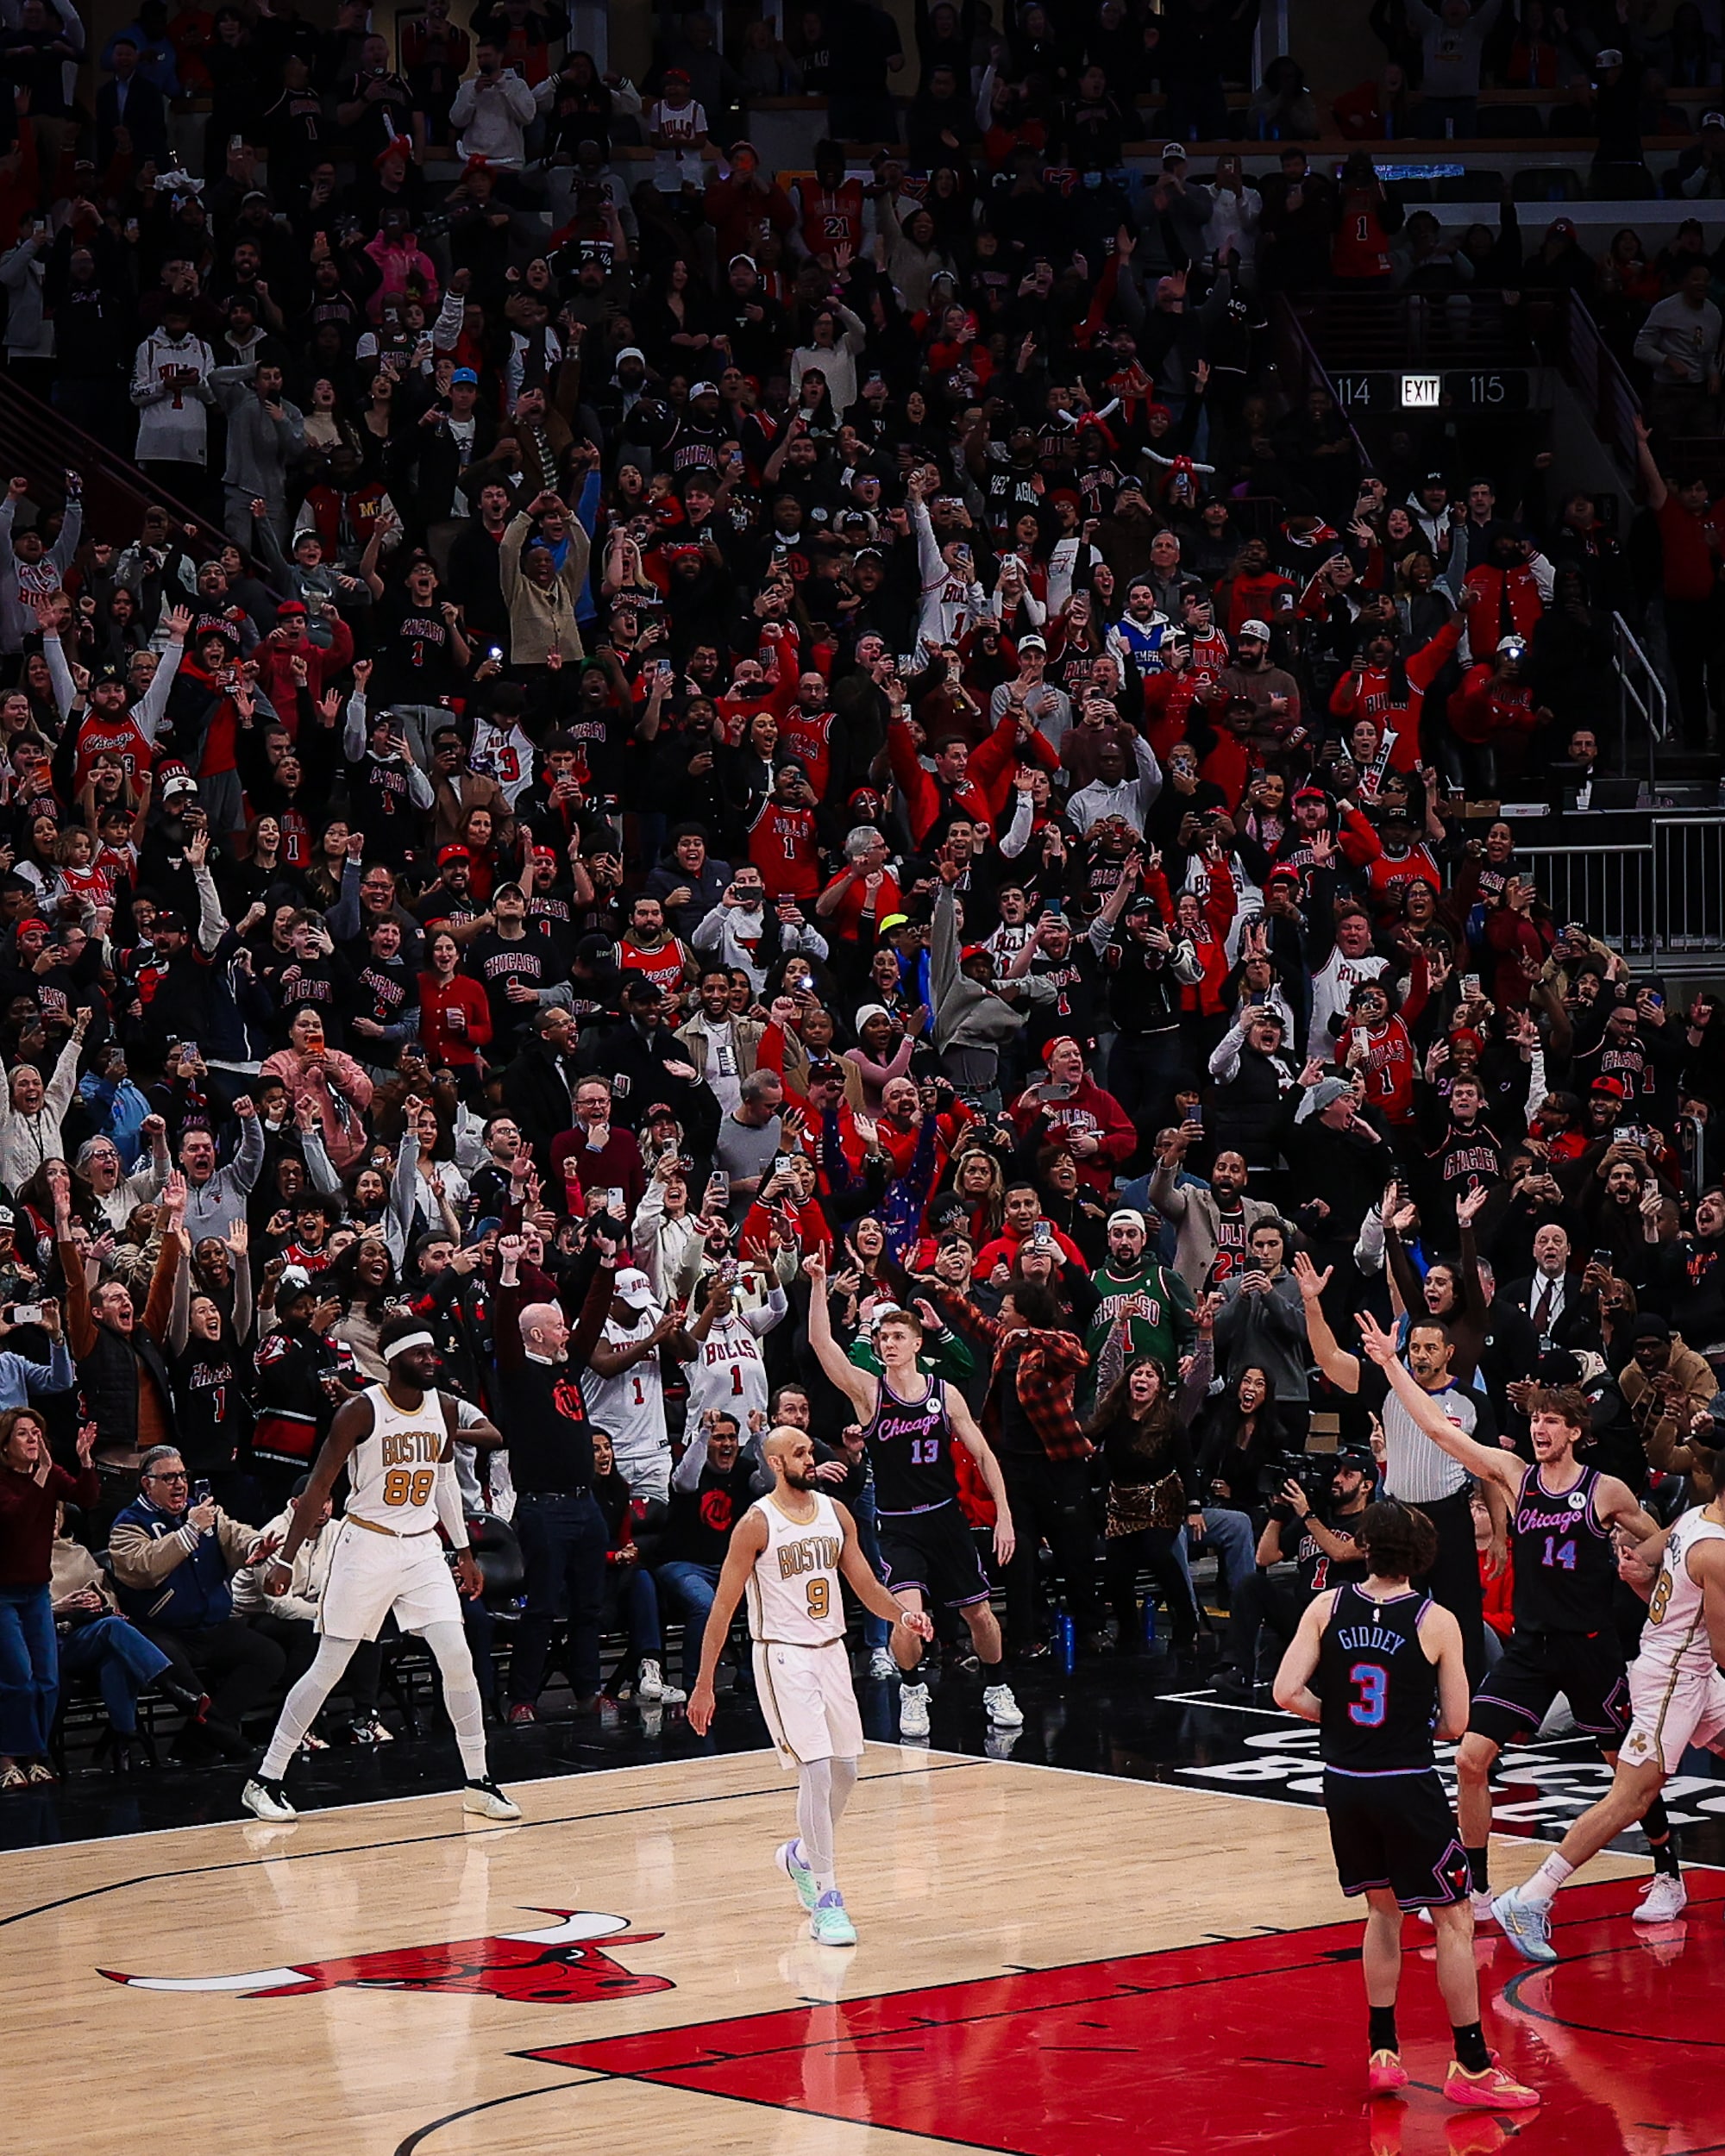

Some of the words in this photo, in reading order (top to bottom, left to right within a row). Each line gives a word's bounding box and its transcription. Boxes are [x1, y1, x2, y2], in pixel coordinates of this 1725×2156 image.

[824, 216, 851, 240] 21
[1356, 216, 1367, 241] 1
[1338, 378, 1371, 405] 114
[1405, 379, 1439, 403] EXIT
[1470, 377, 1505, 404] 115
[942, 582, 969, 605] BUL
[951, 612, 967, 641] 1
[410, 640, 424, 667] 1
[381, 790, 395, 815] 1
[287, 834, 300, 862] 1
[783, 836, 796, 861] 1
[484, 952, 543, 981] CHICAGO
[1380, 1064, 1396, 1096] 1
[1215, 1223, 1245, 1250] ULL
[1091, 1292, 1161, 1330] CHICGO
[706, 1337, 757, 1366] BULLS
[633, 1377, 646, 1406] 1
[730, 1364, 743, 1396] 1
[213, 1387, 226, 1424] 1
[877, 1413, 941, 1442] Chicago
[382, 1432, 442, 1467] BOSTON
[910, 1438, 940, 1466] 13
[383, 1469, 436, 1507] 88
[1516, 1509, 1584, 1534] Chicago
[777, 1537, 840, 1581] BOSTON
[1540, 1535, 1578, 1570] 14
[1310, 1557, 1331, 1590] 1
[806, 1578, 830, 1620] 9
[1339, 1626, 1407, 1657] GIDDEY
[1346, 1661, 1390, 1729] 3
